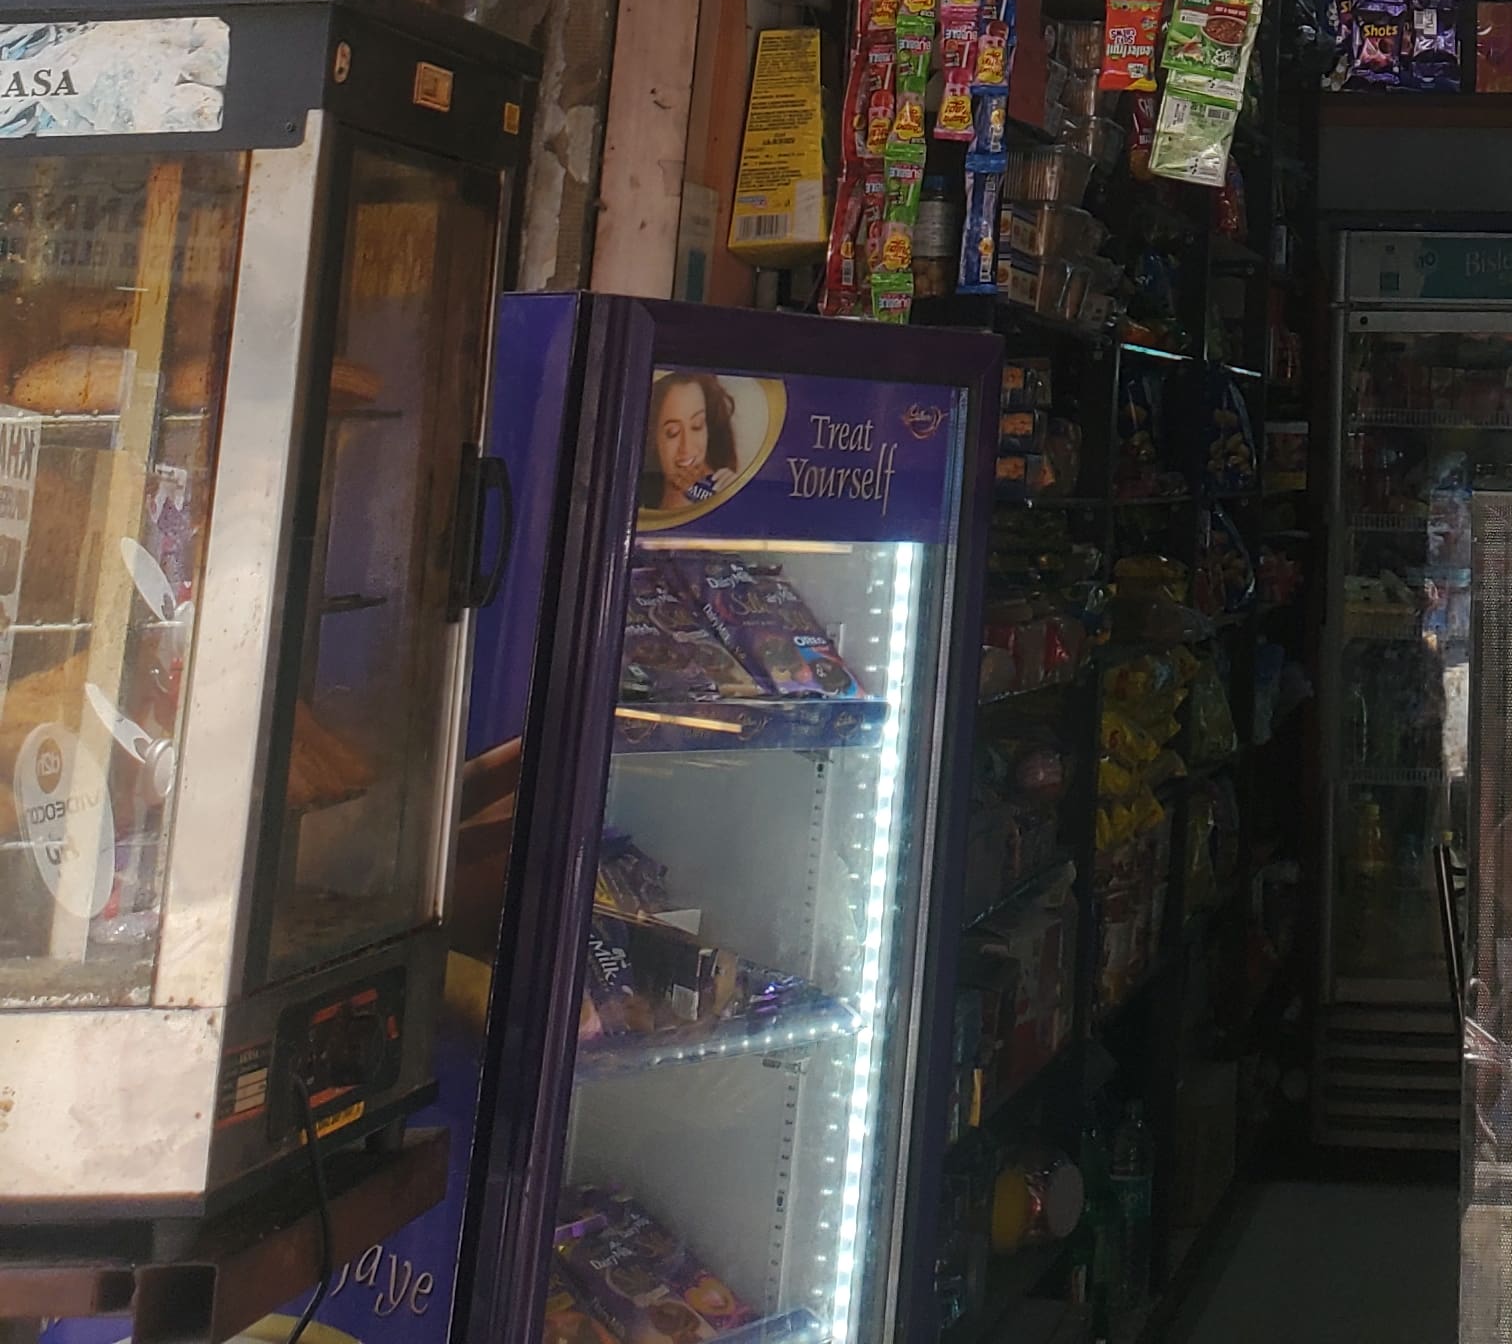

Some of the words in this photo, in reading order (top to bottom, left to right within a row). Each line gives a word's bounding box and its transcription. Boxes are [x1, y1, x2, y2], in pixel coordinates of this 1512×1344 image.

[1363, 24, 1398, 38] Shots
[810, 414, 874, 452] Treat
[786, 442, 898, 517] Yourself
